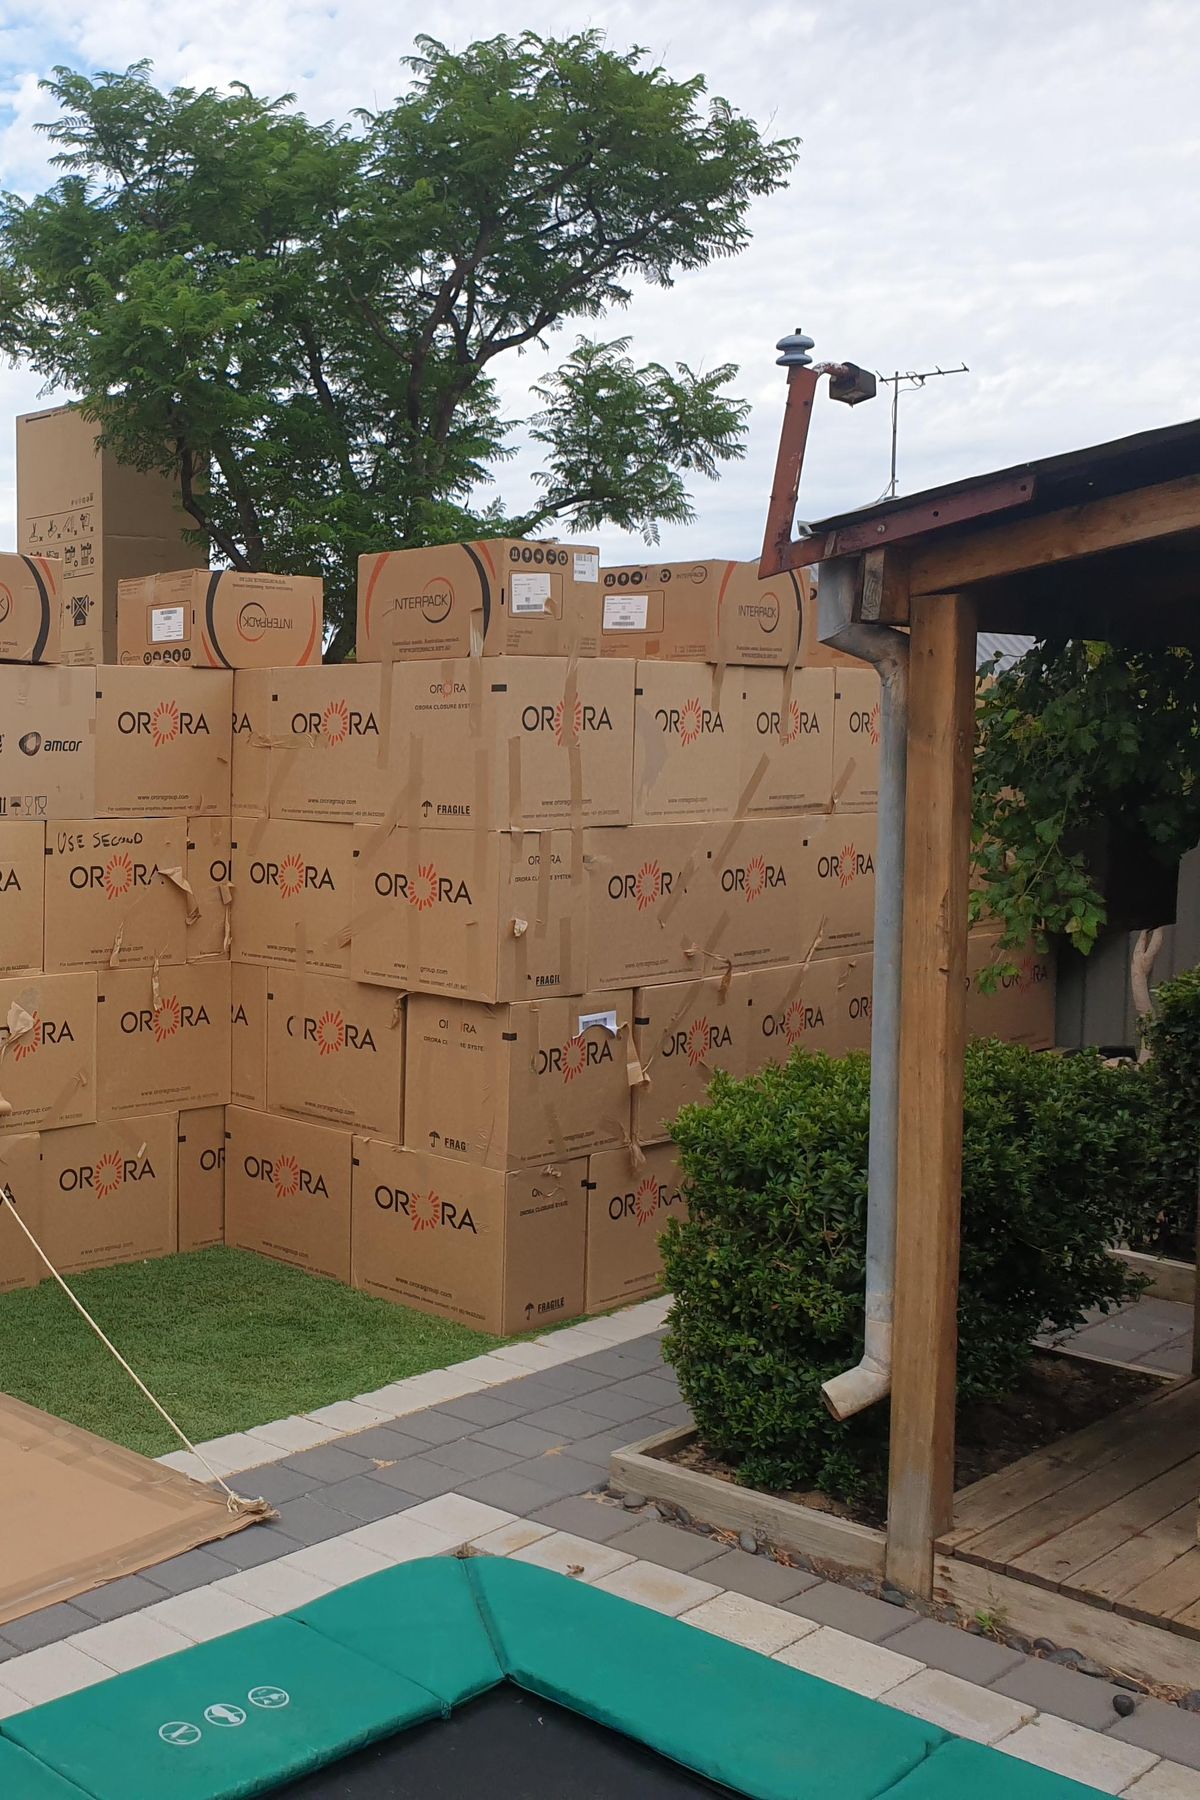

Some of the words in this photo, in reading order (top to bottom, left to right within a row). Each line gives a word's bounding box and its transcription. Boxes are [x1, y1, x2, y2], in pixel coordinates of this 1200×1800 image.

[242, 614, 293, 630] INTERPACK
[738, 604, 777, 618] INTERPACK
[429, 680, 466, 700] ORORA
[43, 739, 83, 752] amcor
[117, 700, 210, 747] ORORA
[291, 699, 380, 747] ORORA
[437, 804, 472, 815] FRAGILE
[57, 832, 85, 855] USE
[93, 832, 143, 849] SECOND
[528, 855, 561, 865] ORRA
[817, 843, 875, 889] ORORA
[250, 854, 335, 899] ORORA
[374, 863, 472, 912] ORORA
[721, 855, 787, 903] ORORA
[120, 995, 211, 1043] ORORA
[762, 999, 825, 1046] ORORA
[444, 1137, 468, 1151] FRAG
[59, 1150, 156, 1199] ORORA
[244, 1154, 329, 1199] ORORA
[374, 1185, 477, 1234] ORORA
[395, 1277, 452, 1299] www.ororagroup.com
[537, 1296, 565, 1314] FRAGILE
